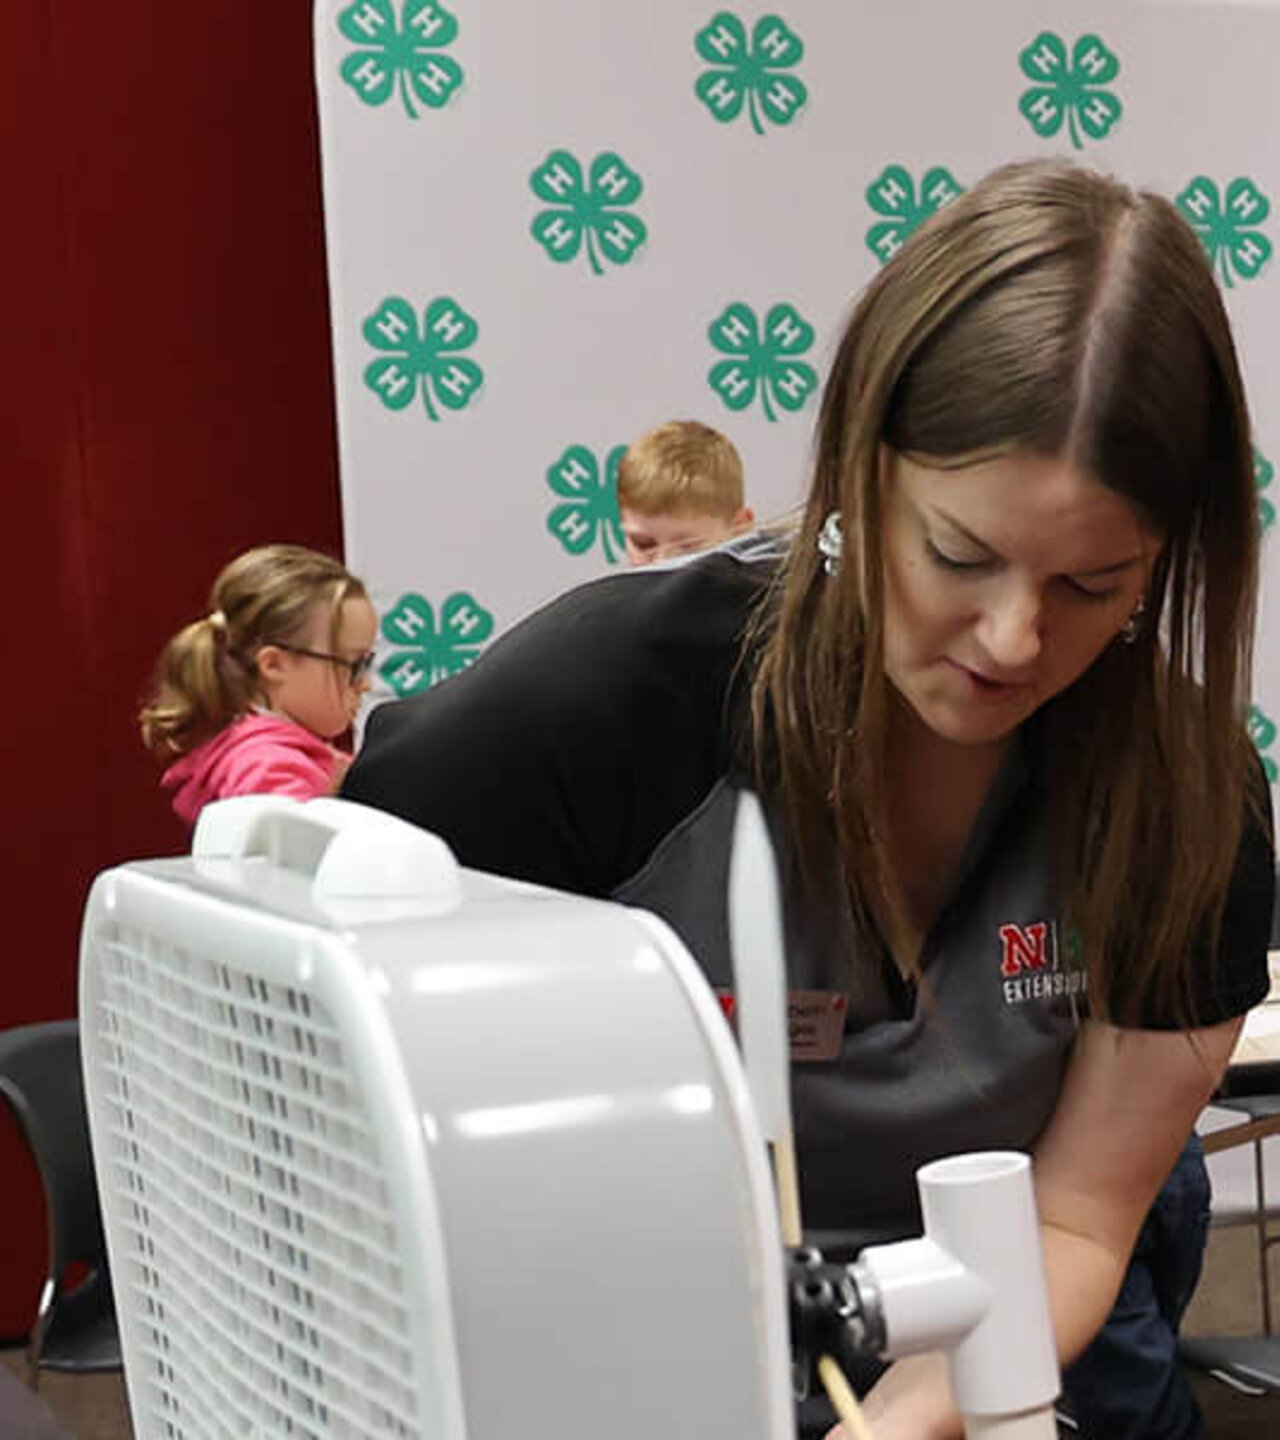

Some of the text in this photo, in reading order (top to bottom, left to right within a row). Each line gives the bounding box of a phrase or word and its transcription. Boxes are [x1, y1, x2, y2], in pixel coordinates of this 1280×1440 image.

[354, 4, 452, 94] H H H H
[708, 26, 797, 113] H H H H
[1030, 46, 1113, 126] H H H H
[545, 165, 635, 251] H H H H
[879, 179, 907, 209] H
[1186, 190, 1263, 265] H H H
[377, 312, 471, 396] H H H H
[722, 316, 805, 398] H H H H
[560, 460, 589, 542] H H
[393, 607, 478, 689] H H H
[998, 921, 1048, 977] N
